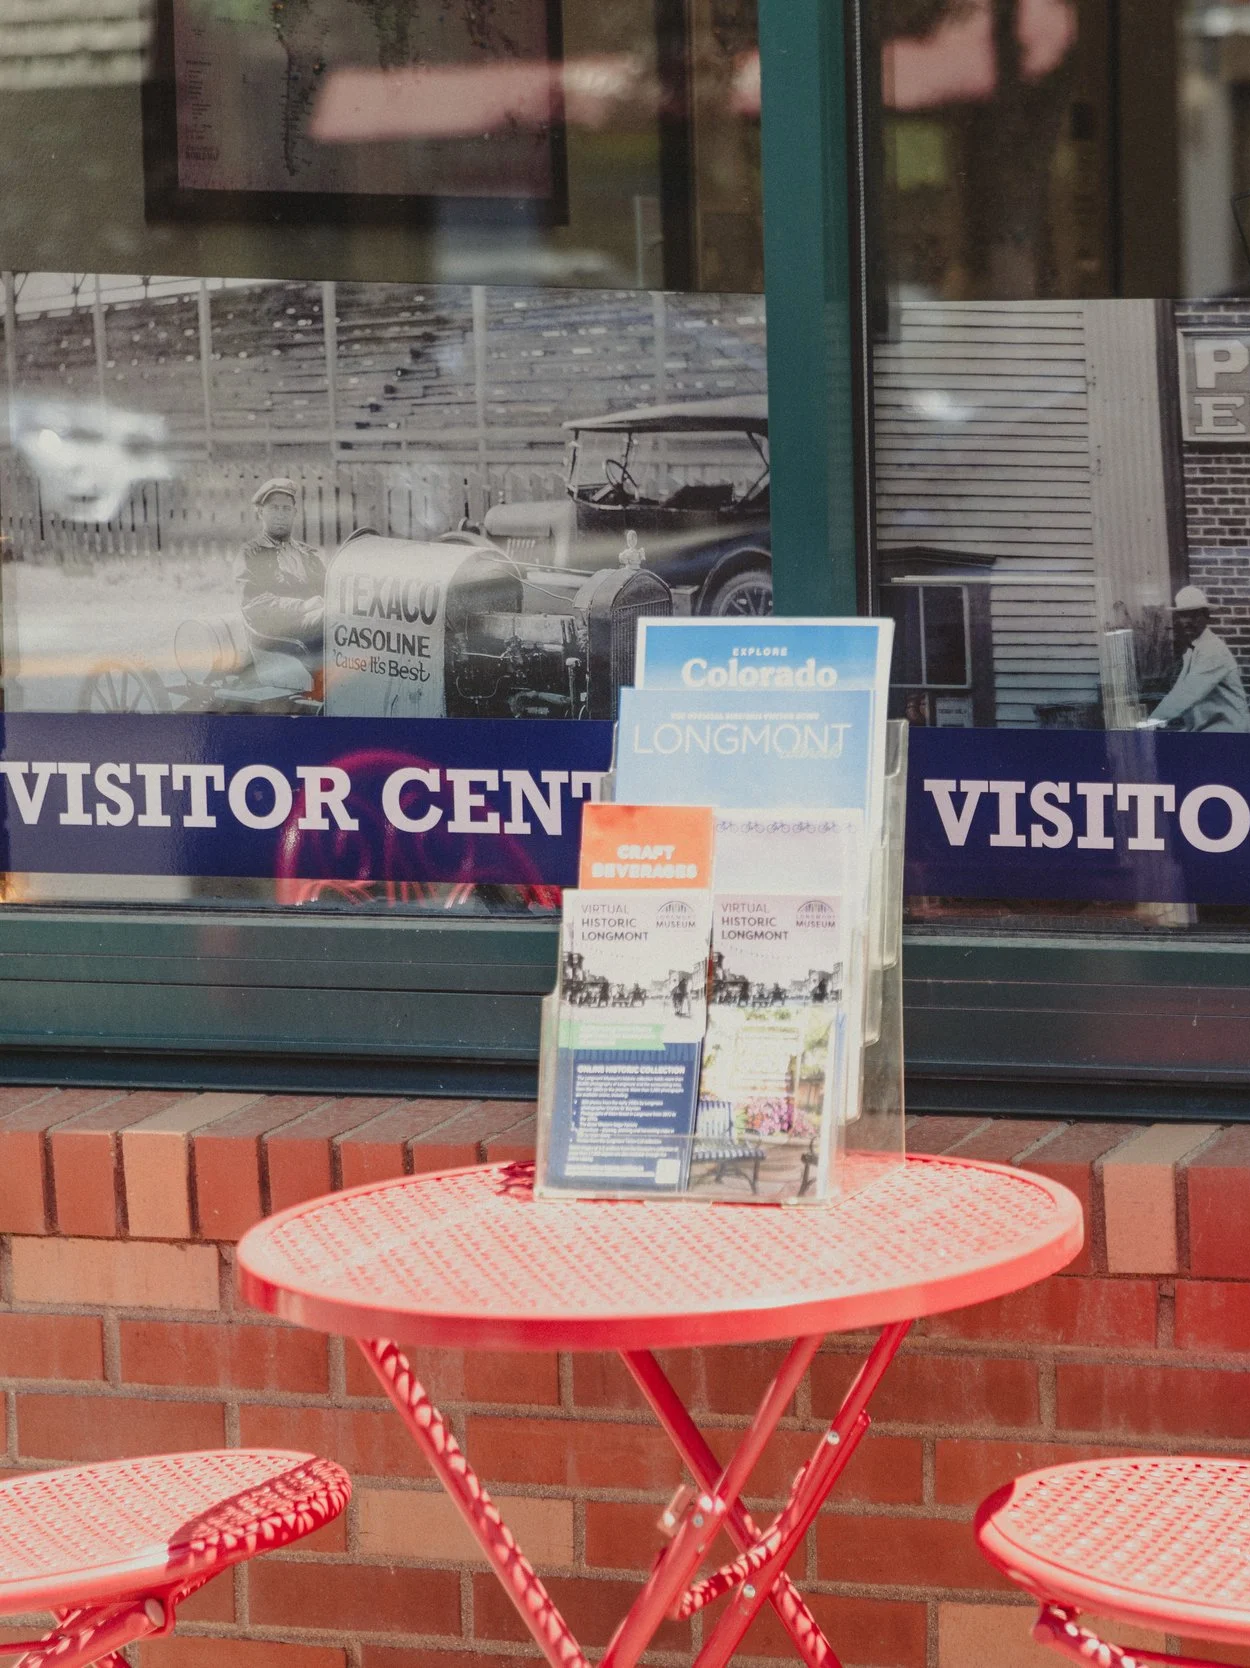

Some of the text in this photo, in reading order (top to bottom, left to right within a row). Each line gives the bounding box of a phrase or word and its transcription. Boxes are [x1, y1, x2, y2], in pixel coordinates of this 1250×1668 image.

[336, 571, 441, 625] TEXACO
[333, 624, 431, 659] GASOLINE
[732, 647, 788, 657] EXPLORE
[388, 659, 431, 682] Best
[681, 657, 838, 689] Colorado
[634, 722, 852, 755] LONGMONT
[0, 761, 358, 831] VISITOR
[616, 845, 676, 860] CRAFT
[591, 863, 697, 879] BEVERAGES
[581, 904, 629, 914] VIRTUAL
[721, 903, 769, 914] VIRTUAL
[581, 918, 637, 928] HISTORIC
[656, 921, 696, 929] MUSEUM
[721, 917, 776, 927] HISTORIC
[796, 920, 836, 928] MUSEUM
[581, 931, 648, 941] LONGMONT
[721, 930, 788, 940] LONGMONT
